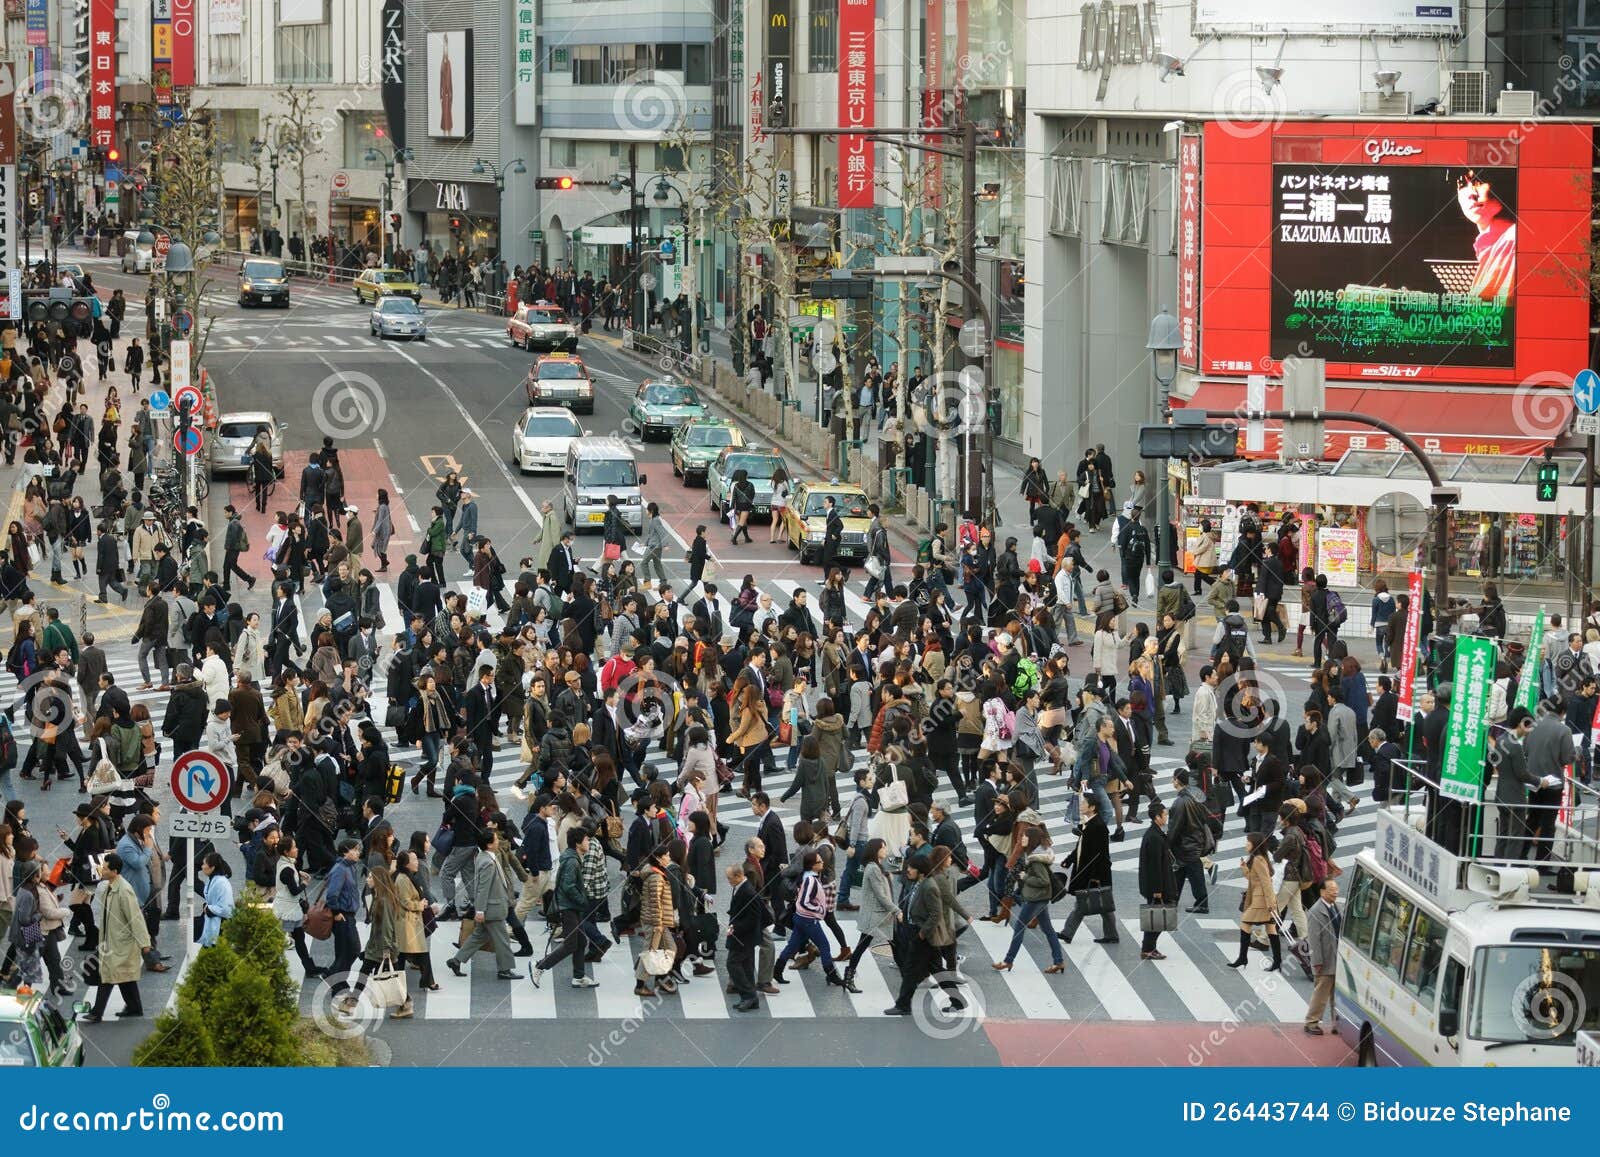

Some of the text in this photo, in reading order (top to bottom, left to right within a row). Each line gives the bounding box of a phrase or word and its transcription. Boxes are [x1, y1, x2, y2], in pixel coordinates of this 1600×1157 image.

[384, 9, 403, 84] ZARA
[96, 31, 111, 145] 東日本銀行
[1365, 139, 1422, 163] Glico
[1280, 175, 1390, 191] バンドネオン奏者
[436, 183, 469, 211] ZARA
[1280, 193, 1392, 223] 三浦一馬
[1281, 225, 1392, 244] KAZUMA MIURA
[173, 820, 226, 833] ここから
